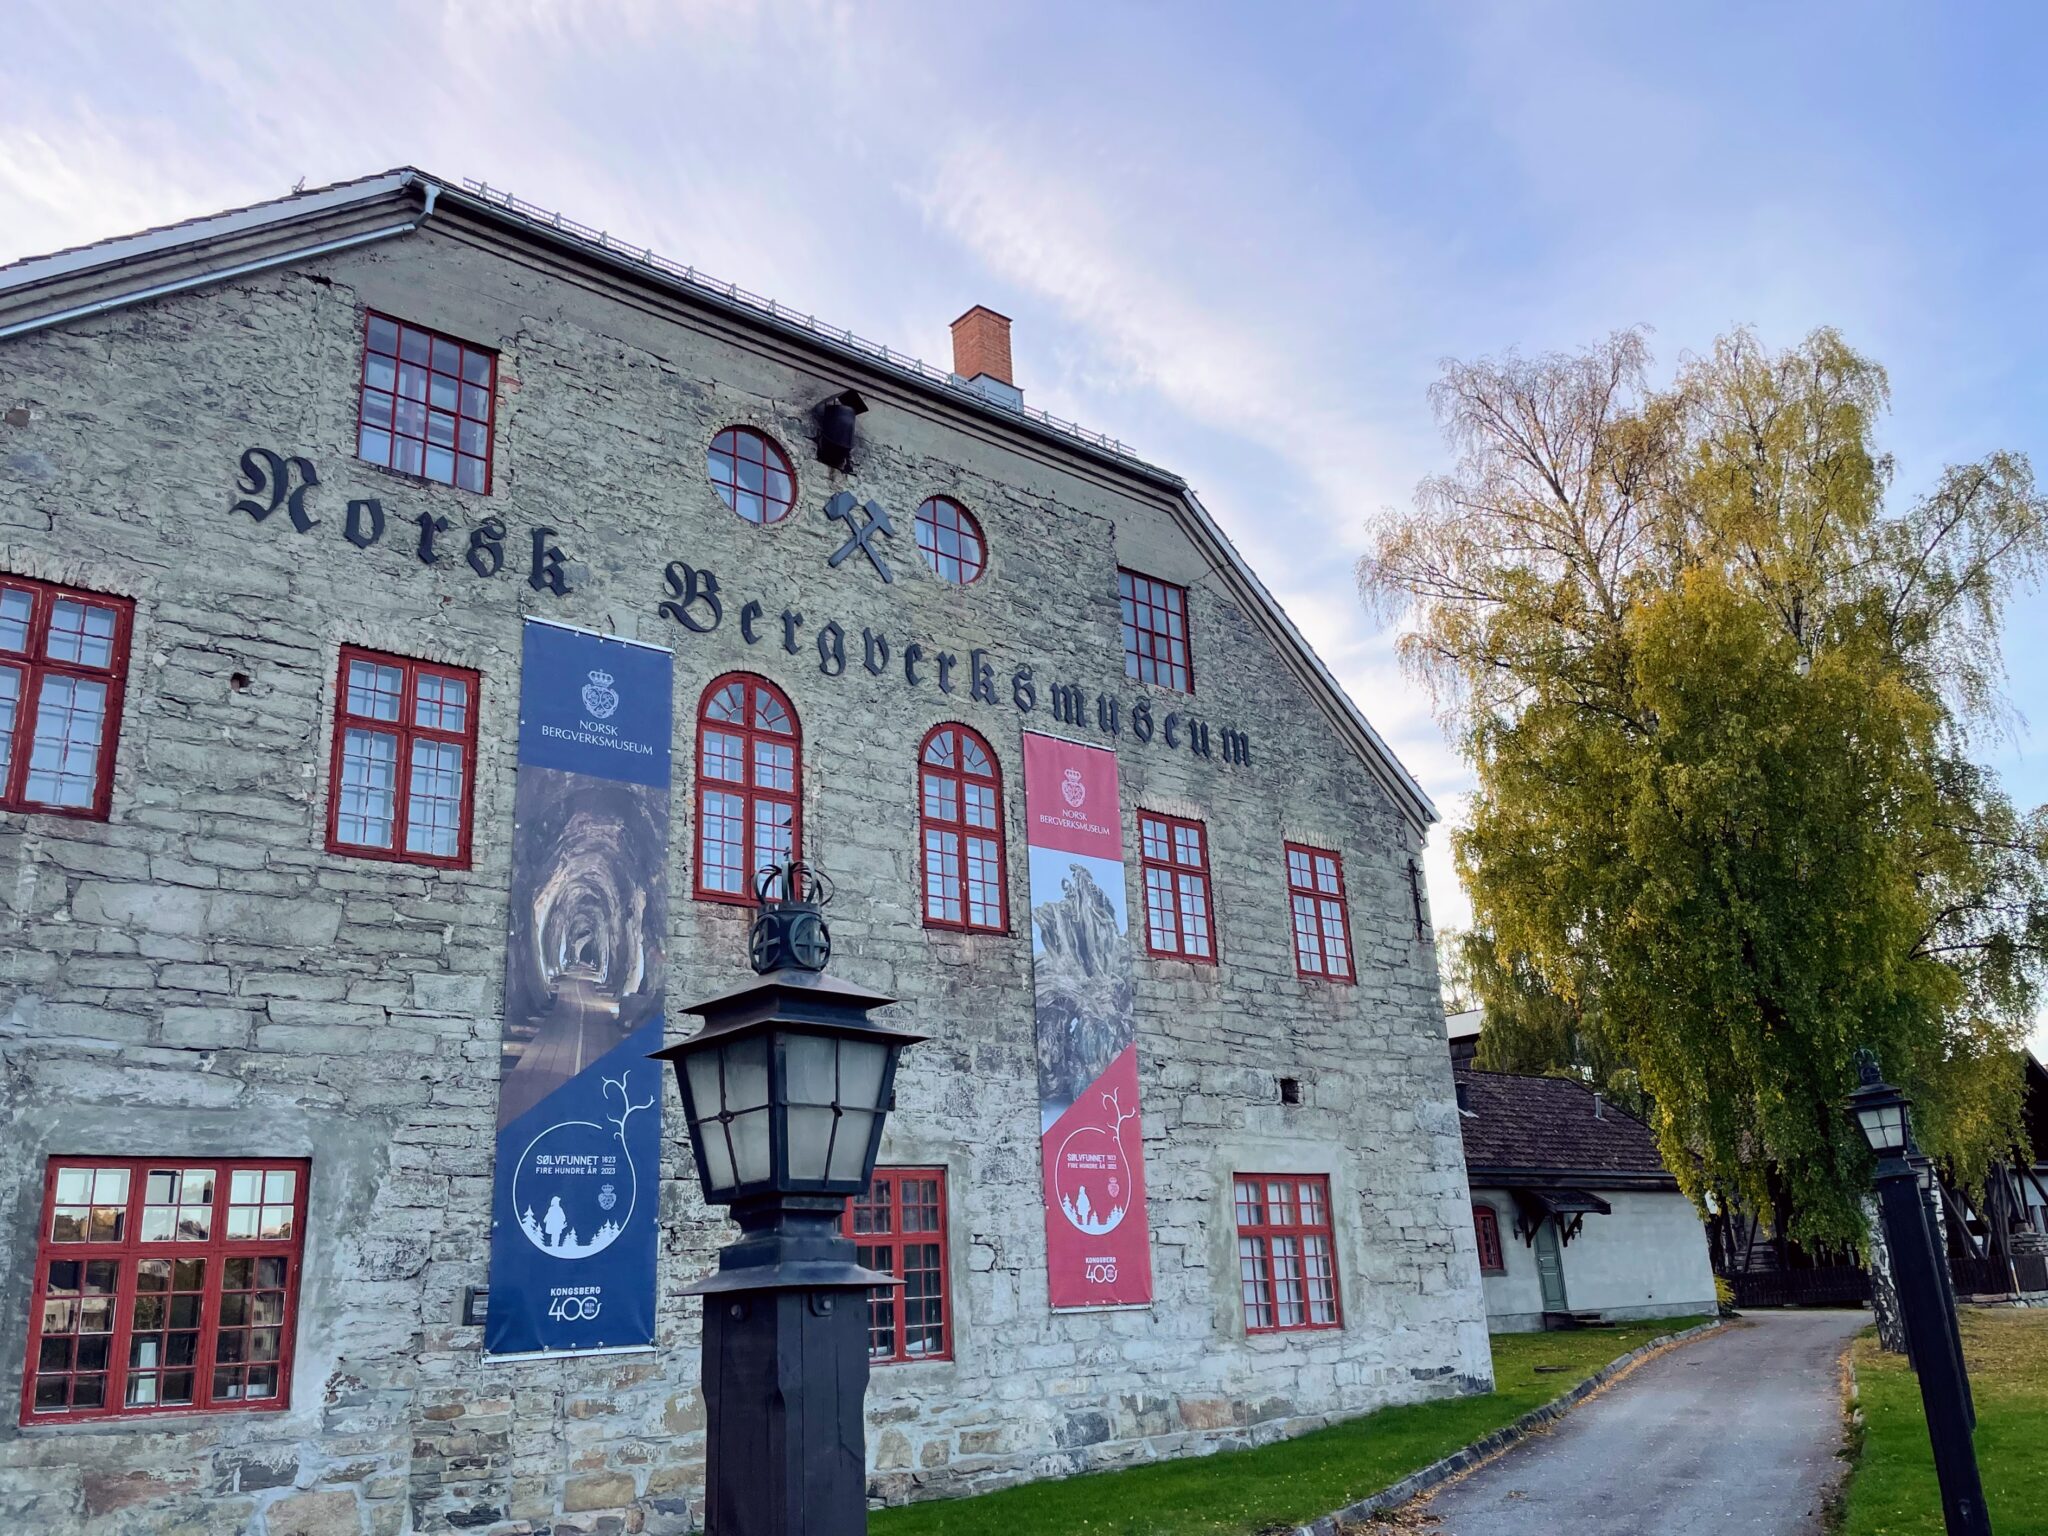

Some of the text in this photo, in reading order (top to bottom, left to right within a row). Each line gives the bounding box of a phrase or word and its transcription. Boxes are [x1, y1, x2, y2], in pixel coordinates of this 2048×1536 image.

[230, 447, 1251, 767] Norsk Bergverksmuseum
[579, 719, 619, 737] NORSK
[541, 725, 653, 756] BERGVERKSMUSEUM
[1062, 808, 1088, 821] NORSK
[1040, 814, 1110, 835] BERGVERKSMUSEUM
[536, 1154, 599, 1165] SØLVFUNNET
[535, 1166, 616, 1175] FIRE HUNDRE ÅR 2023
[550, 1286, 601, 1296] KONGSBERG
[548, 1296, 603, 1322] 400
